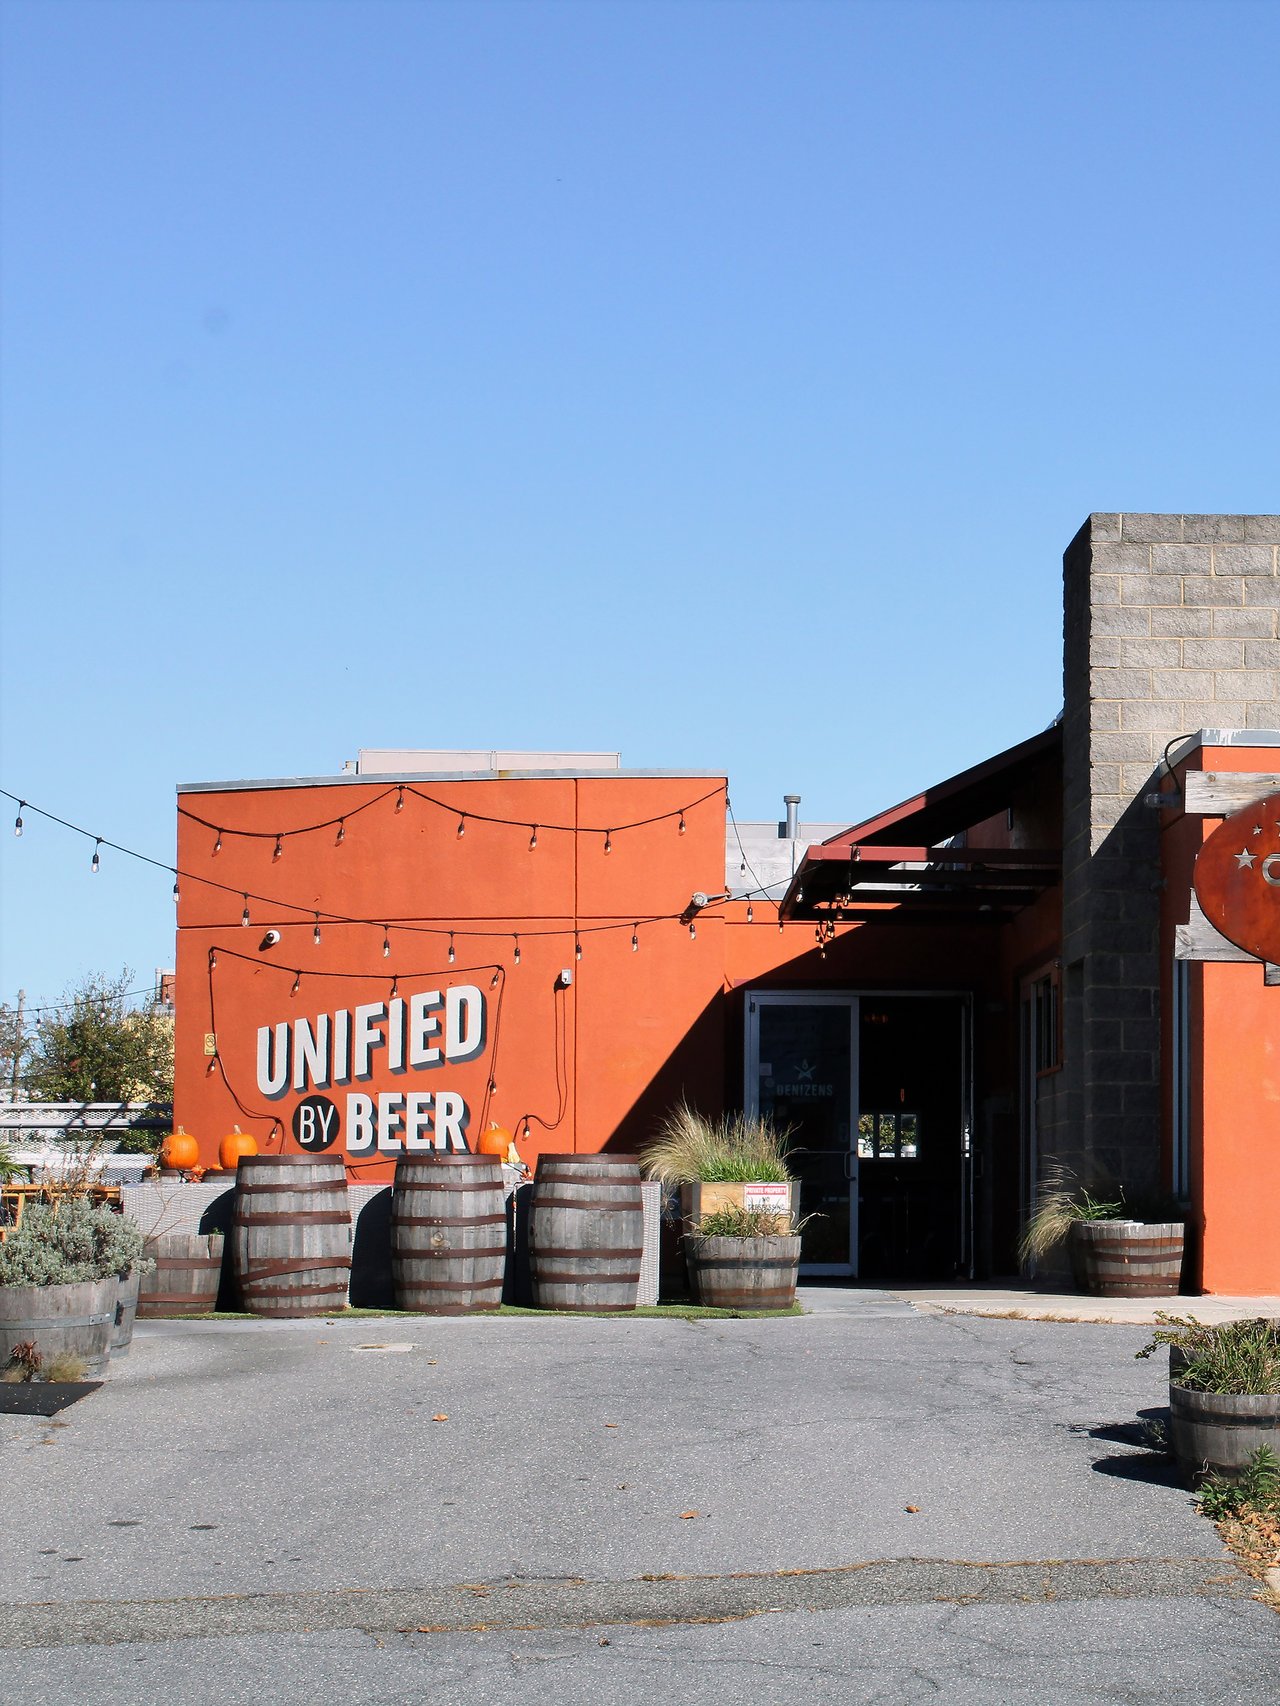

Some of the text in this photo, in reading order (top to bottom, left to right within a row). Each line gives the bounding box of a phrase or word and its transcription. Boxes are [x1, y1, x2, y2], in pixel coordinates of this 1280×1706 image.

[256, 984, 486, 1098] UNIFIED
[776, 1084, 833, 1097] DENIZENS
[299, 1091, 470, 1156] BY BEER
[746, 1186, 786, 1194] PRIVATE PROPERTY
